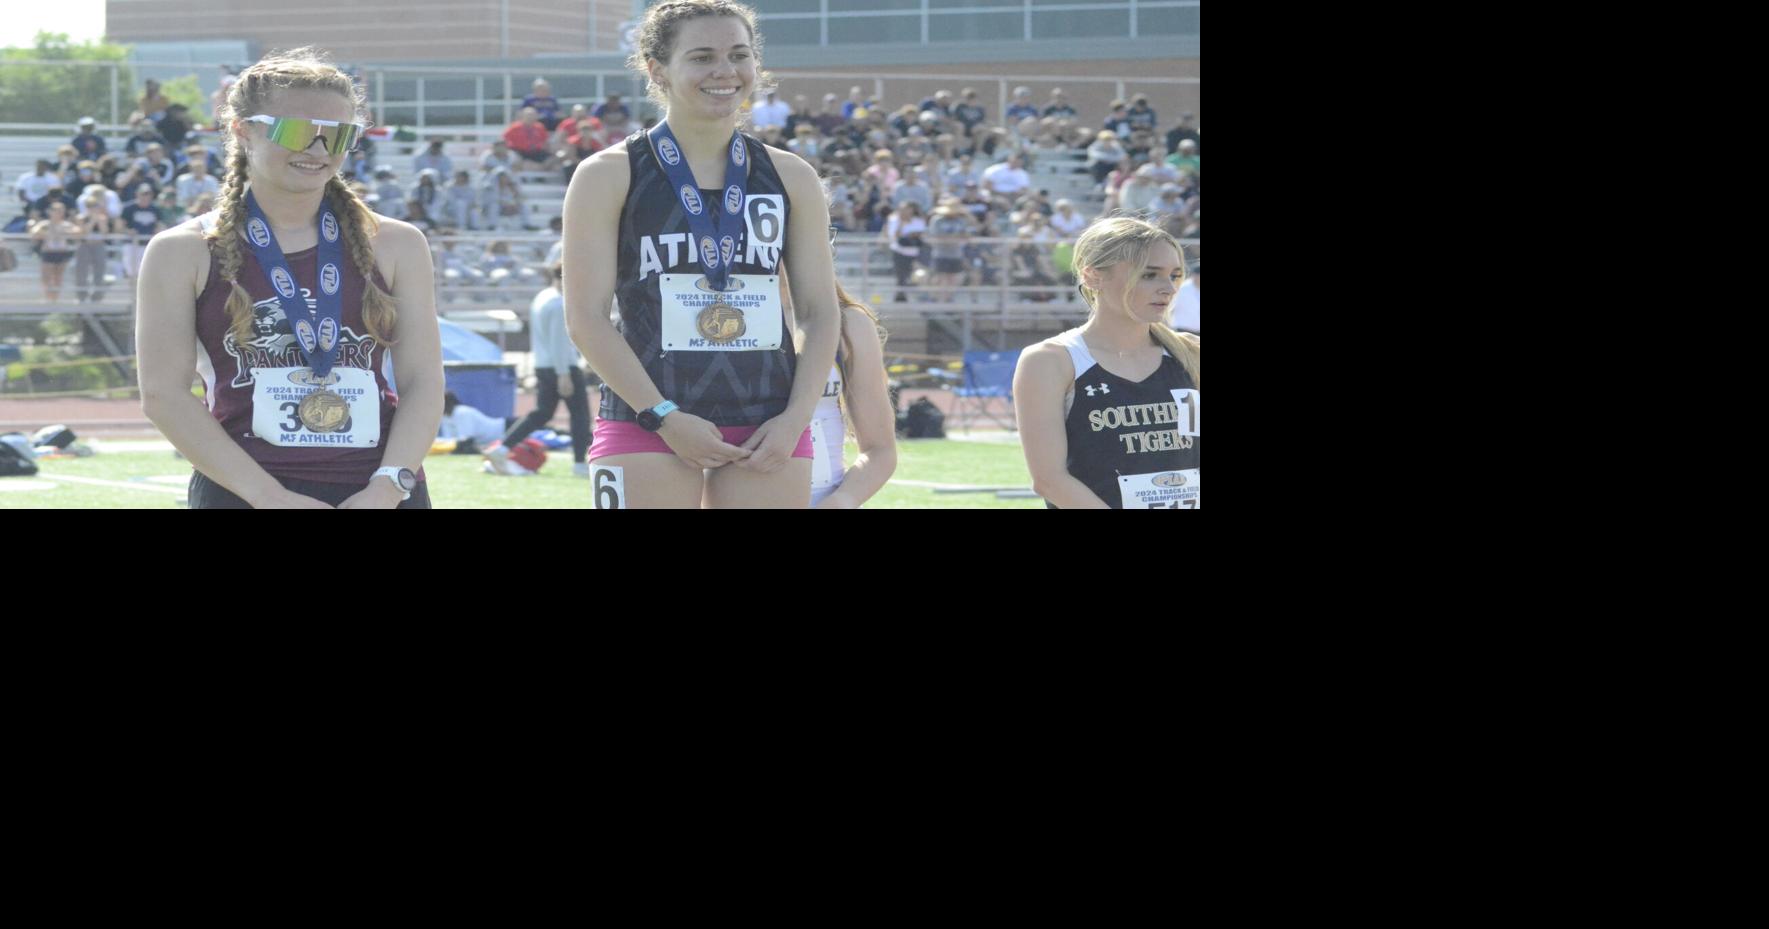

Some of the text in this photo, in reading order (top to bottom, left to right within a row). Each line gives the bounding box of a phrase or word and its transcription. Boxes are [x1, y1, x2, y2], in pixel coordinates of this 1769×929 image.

[748, 197, 779, 243] 6
[639, 232, 779, 281] ATNS
[743, 294, 766, 302] FIELD
[232, 336, 377, 387] PANTERS
[266, 386, 291, 394] 2024
[295, 387, 321, 395] TRAC
[274, 394, 357, 402] CHAMIPS
[1180, 391, 1196, 433] 1
[301, 435, 353, 443] ATHLETIC
[1120, 429, 1193, 454] TIGERS
[595, 468, 619, 509] 6
